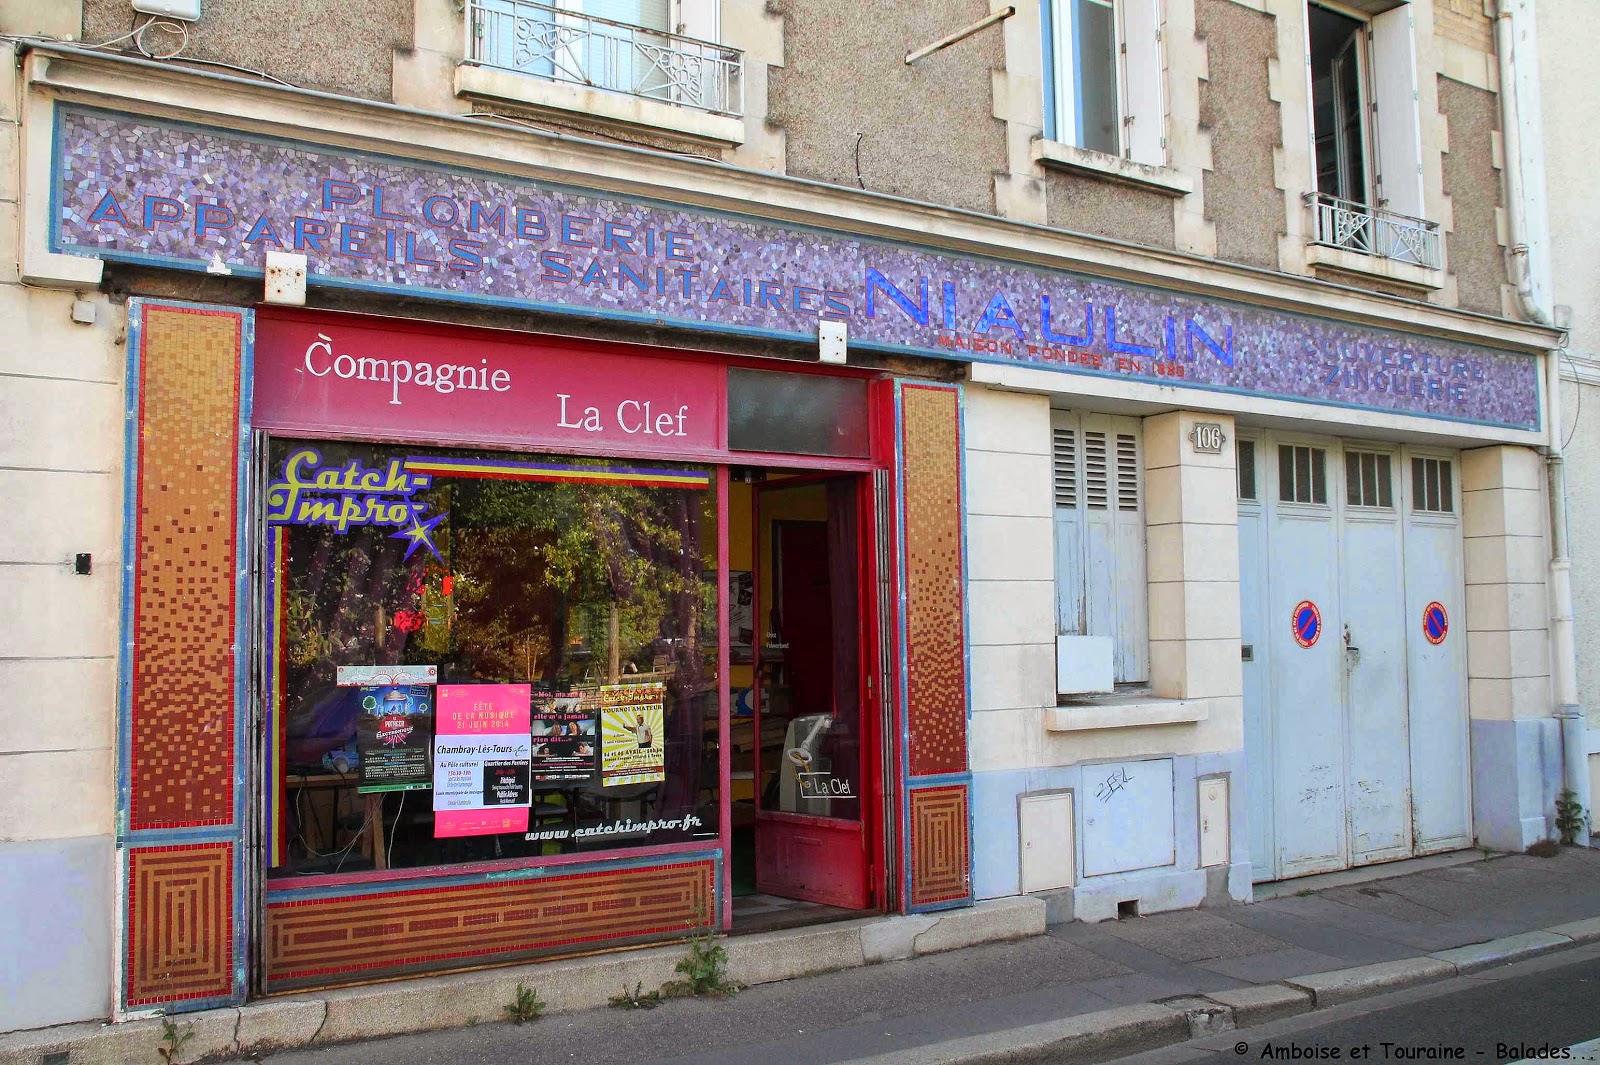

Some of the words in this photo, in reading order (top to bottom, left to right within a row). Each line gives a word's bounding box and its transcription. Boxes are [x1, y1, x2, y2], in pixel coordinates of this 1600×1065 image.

[322, 178, 696, 265] PLOMBERIE
[87, 188, 485, 274] APPAREILS
[541, 249, 852, 319] SANITAIRES
[865, 265, 1233, 368] NIAULIN
[304, 333, 511, 405] Compagnie
[938, 334, 1013, 355] MAISON
[1118, 357, 1142, 373] EN
[1301, 338, 1484, 383] COUVERTURE
[1321, 363, 1468, 404] ZINGUERIE
[556, 393, 603, 432] La
[616, 399, 689, 437] Clef
[1196, 426, 1220, 449] 106
[452, 712, 462, 720] DE
[465, 712, 475, 720] LA
[478, 711, 515, 720] MUSIQUE
[457, 721, 465, 729] 21
[469, 720, 487, 729] JUIN
[473, 701, 493, 711] FÊTE
[563, 712, 589, 720] jamais
[814, 777, 830, 794] La
[830, 777, 852, 795] Clef
[525, 813, 703, 841] www.catchimpro.fr
